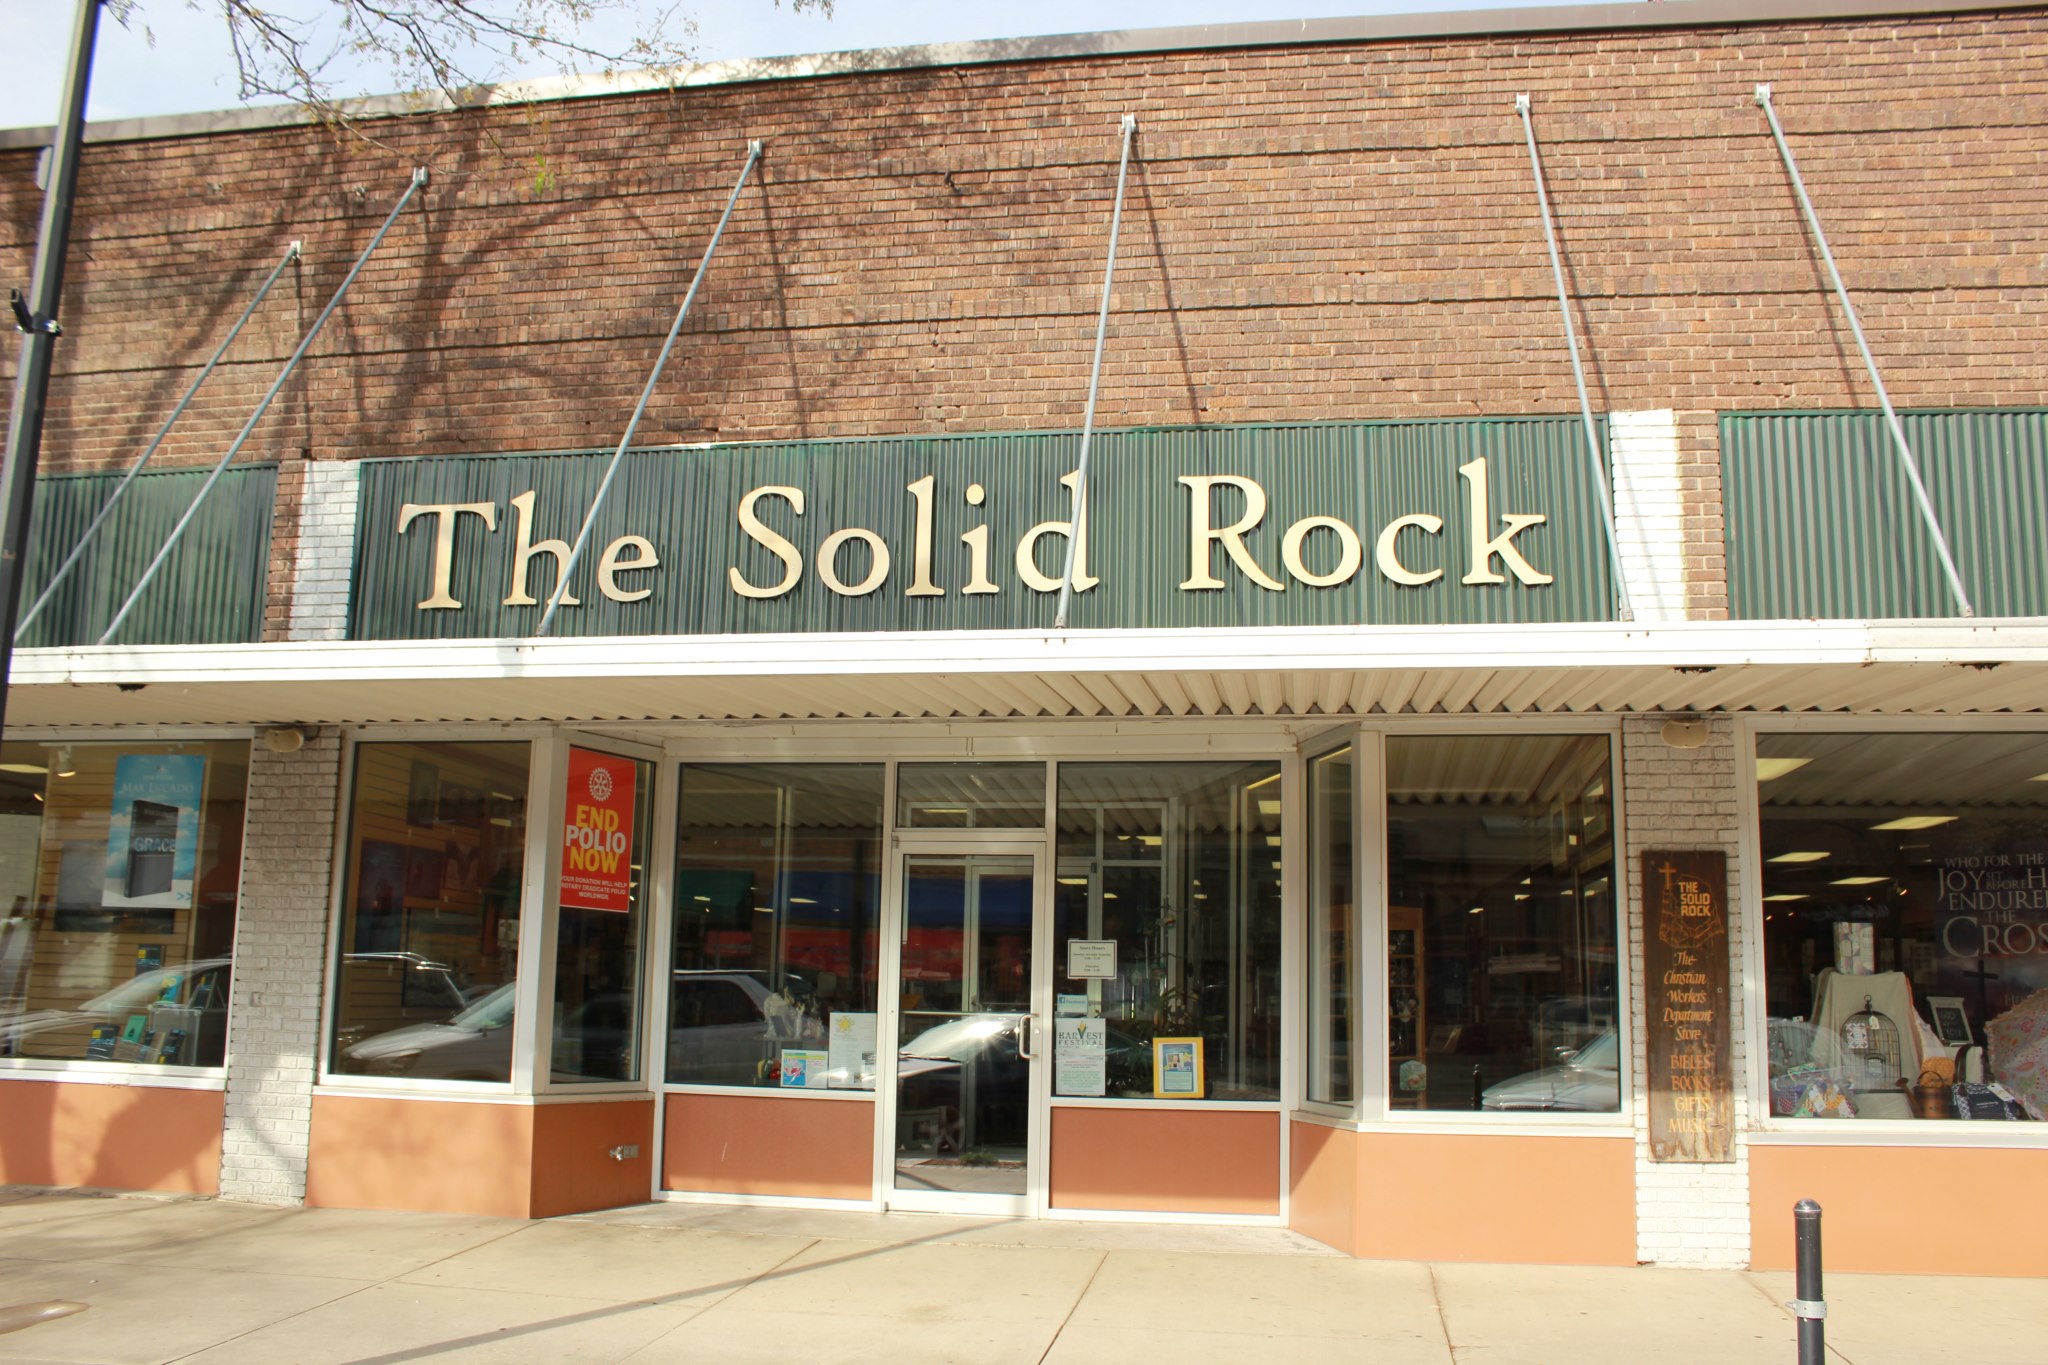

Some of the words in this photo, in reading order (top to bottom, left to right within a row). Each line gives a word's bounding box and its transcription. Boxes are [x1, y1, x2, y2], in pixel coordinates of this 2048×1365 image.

[398, 490, 659, 610] The
[730, 469, 1099, 598] Solid
[1178, 456, 1554, 592] Rock
[576, 804, 619, 832] END
[565, 824, 627, 854] POLIO
[569, 846, 621, 874] NOW
[1944, 856, 1980, 868] WHO
[1984, 854, 2011, 866] FOR
[2016, 853, 2045, 865] THE
[575, 877, 600, 885] DONATION
[1678, 881, 1698, 893] THE
[1937, 868, 1985, 903] JOY
[1680, 893, 1711, 905] SOLID
[1680, 905, 1711, 917] ROCK
[1985, 909, 2016, 923] THE
[1674, 951, 1697, 966] The
[1664, 970, 1707, 985] Christian
[1663, 1007, 1714, 1023] Department
[1058, 1027, 1104, 1040] HARVEST
[1675, 1025, 1701, 1041] Store
[1671, 1054, 1711, 1070] BIBLES
[1672, 1075, 1712, 1091] BOOKS
[1675, 1096, 1710, 1112] GIFTS
[1668, 1118, 1713, 1134] MUSIC
